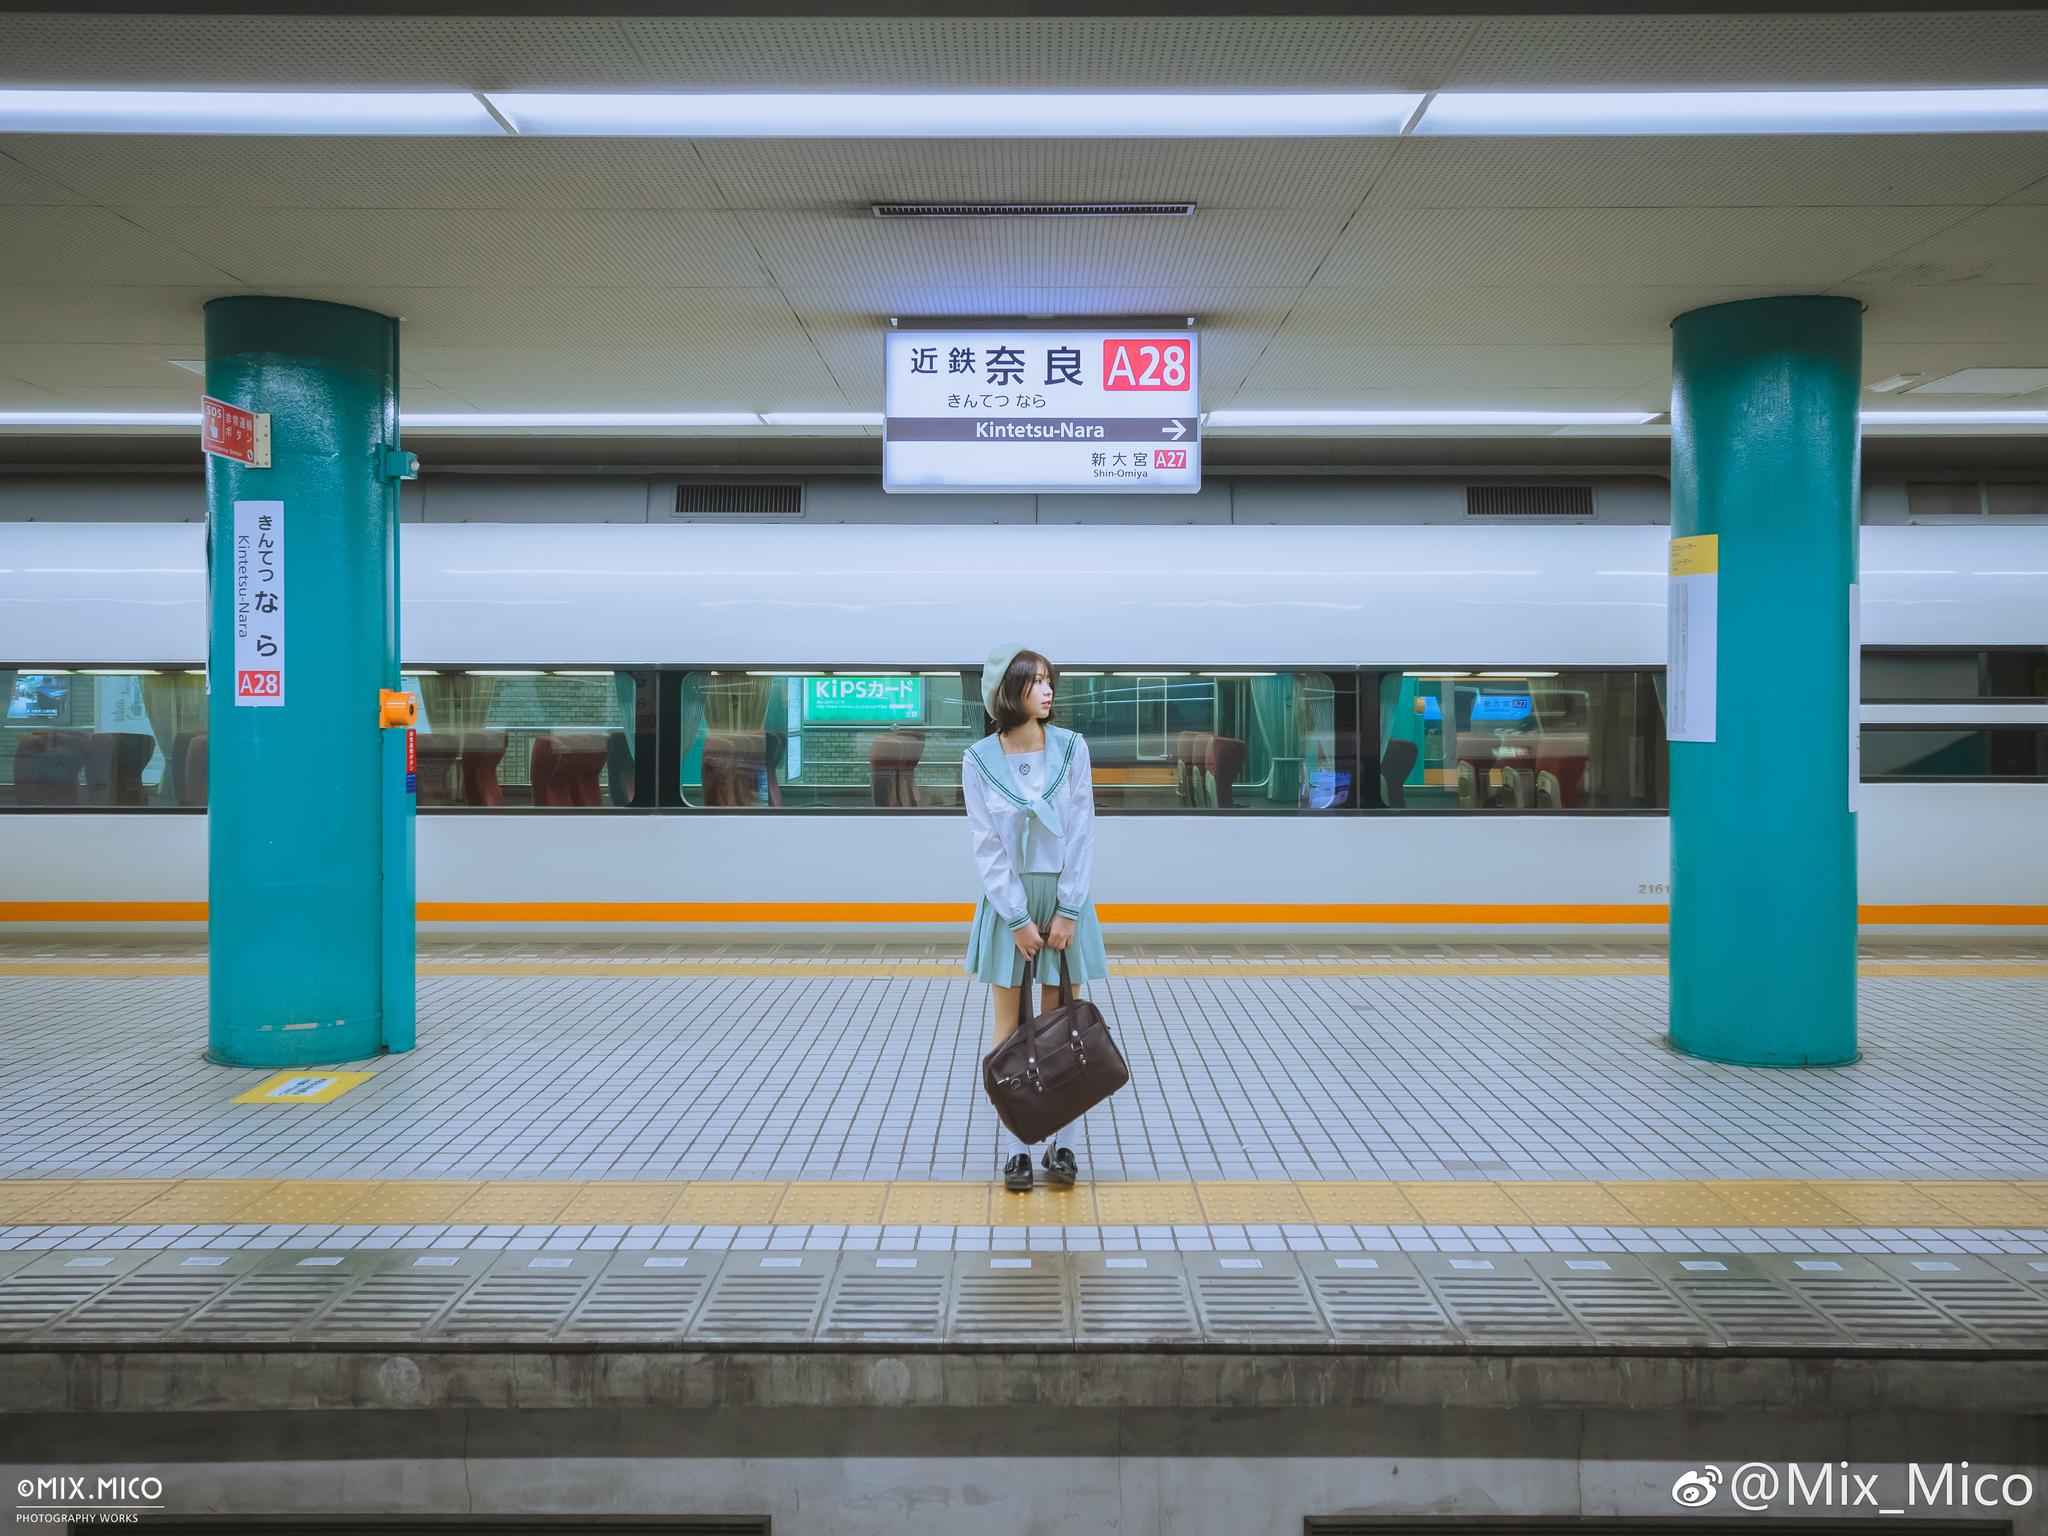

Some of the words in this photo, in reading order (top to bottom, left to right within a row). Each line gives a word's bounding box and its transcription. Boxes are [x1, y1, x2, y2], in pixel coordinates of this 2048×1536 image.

[1107, 345, 1187, 387] A28
[206, 404, 222, 419] SOS
[975, 421, 1105, 439] Kintetsu-Nara
[1091, 451, 1148, 468] 新大宮
[1155, 451, 1186, 468] A27
[1093, 469, 1148, 479] Shin-Omiya
[238, 535, 250, 638] Kintetsu-Nara
[240, 673, 279, 694] A28
